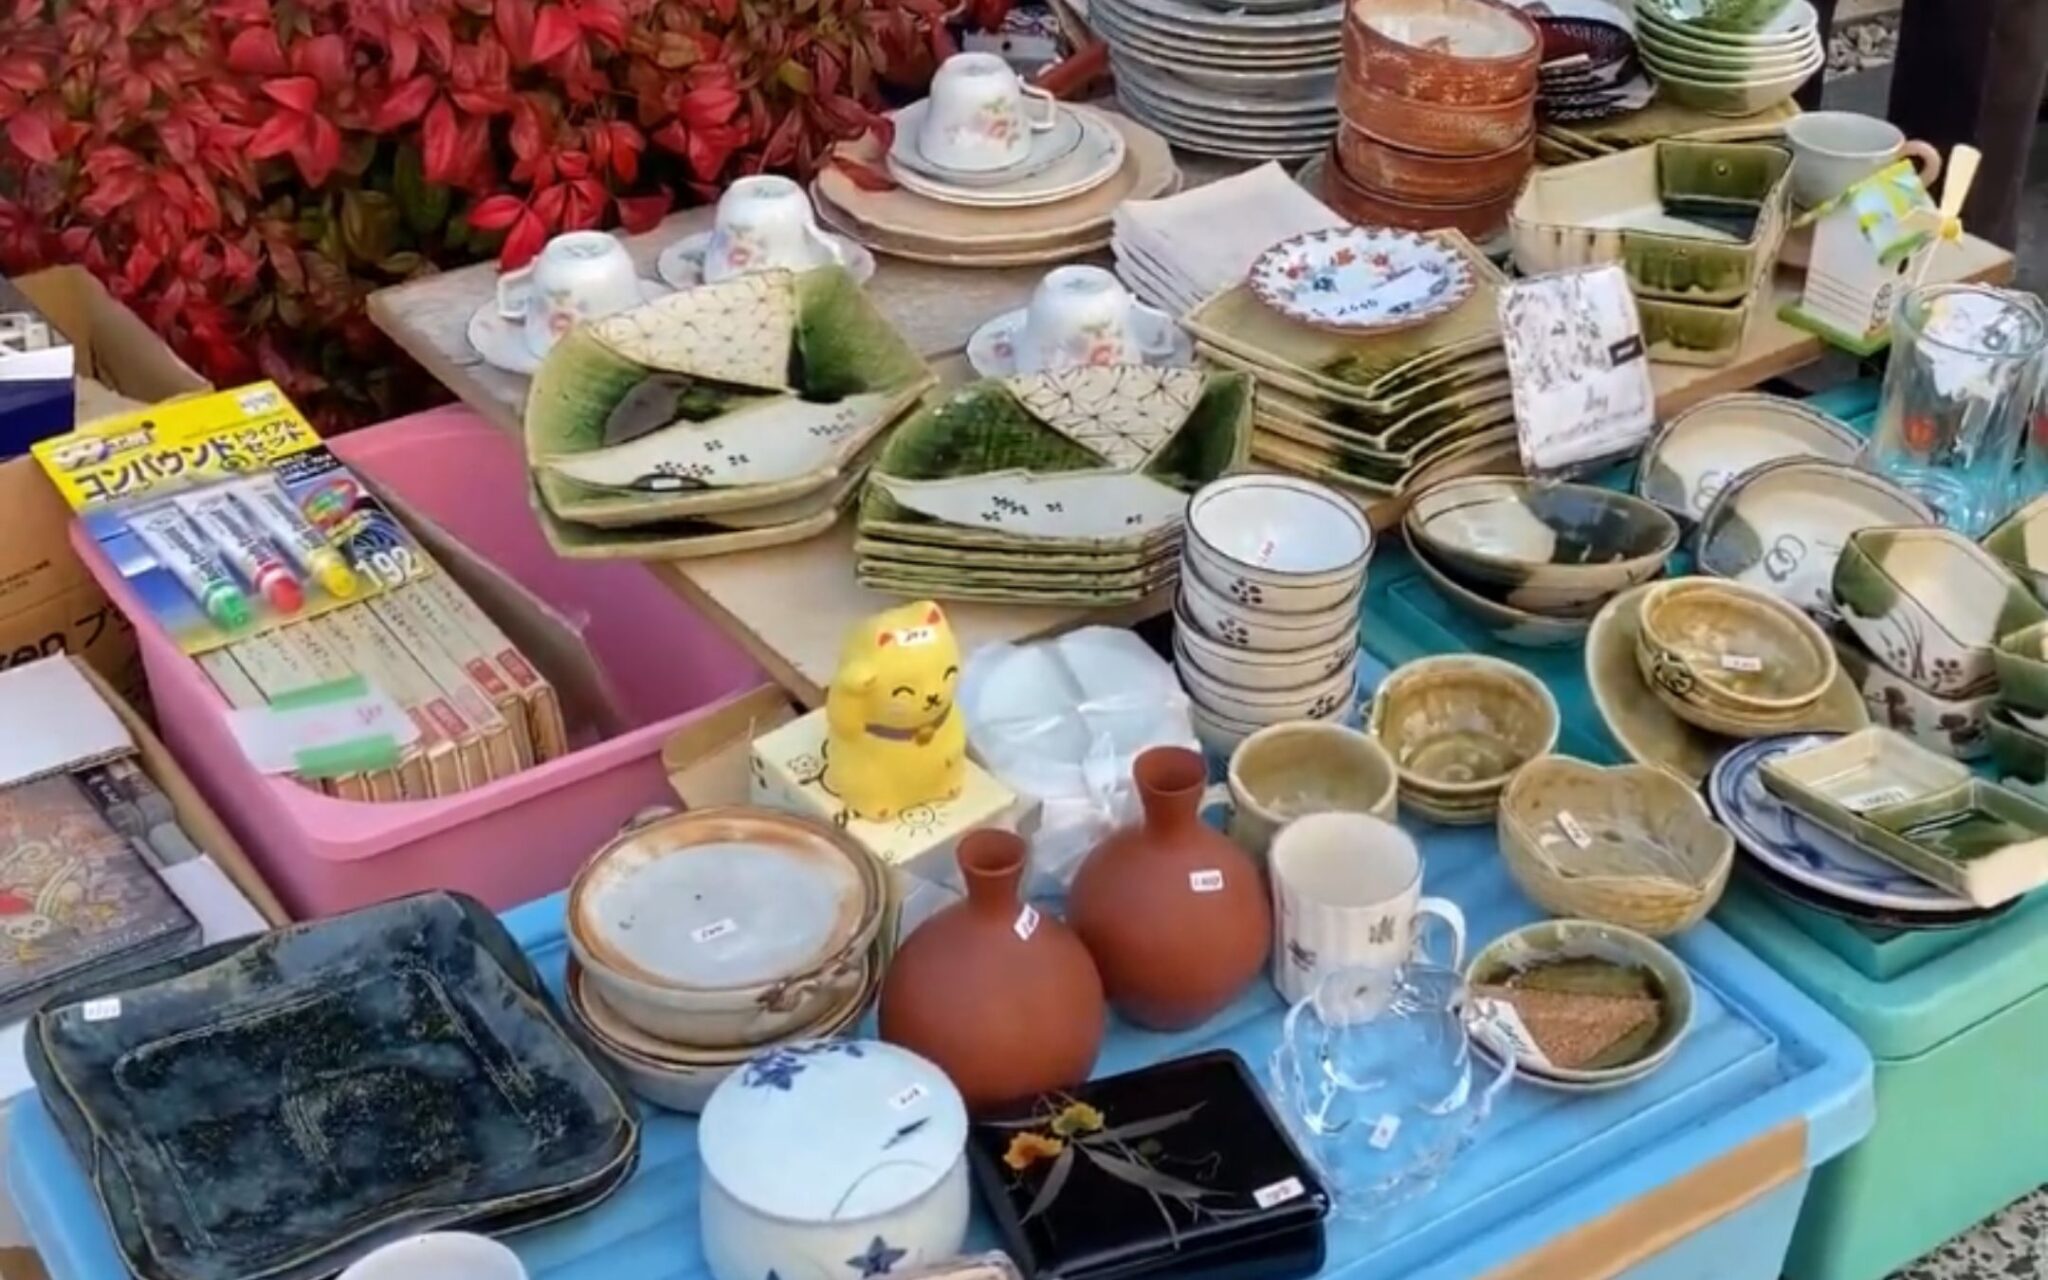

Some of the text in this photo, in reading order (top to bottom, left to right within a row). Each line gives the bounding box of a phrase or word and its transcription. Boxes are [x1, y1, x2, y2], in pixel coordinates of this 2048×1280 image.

[75, 434, 236, 500] コンパウンド
[354, 545, 421, 589] 192
